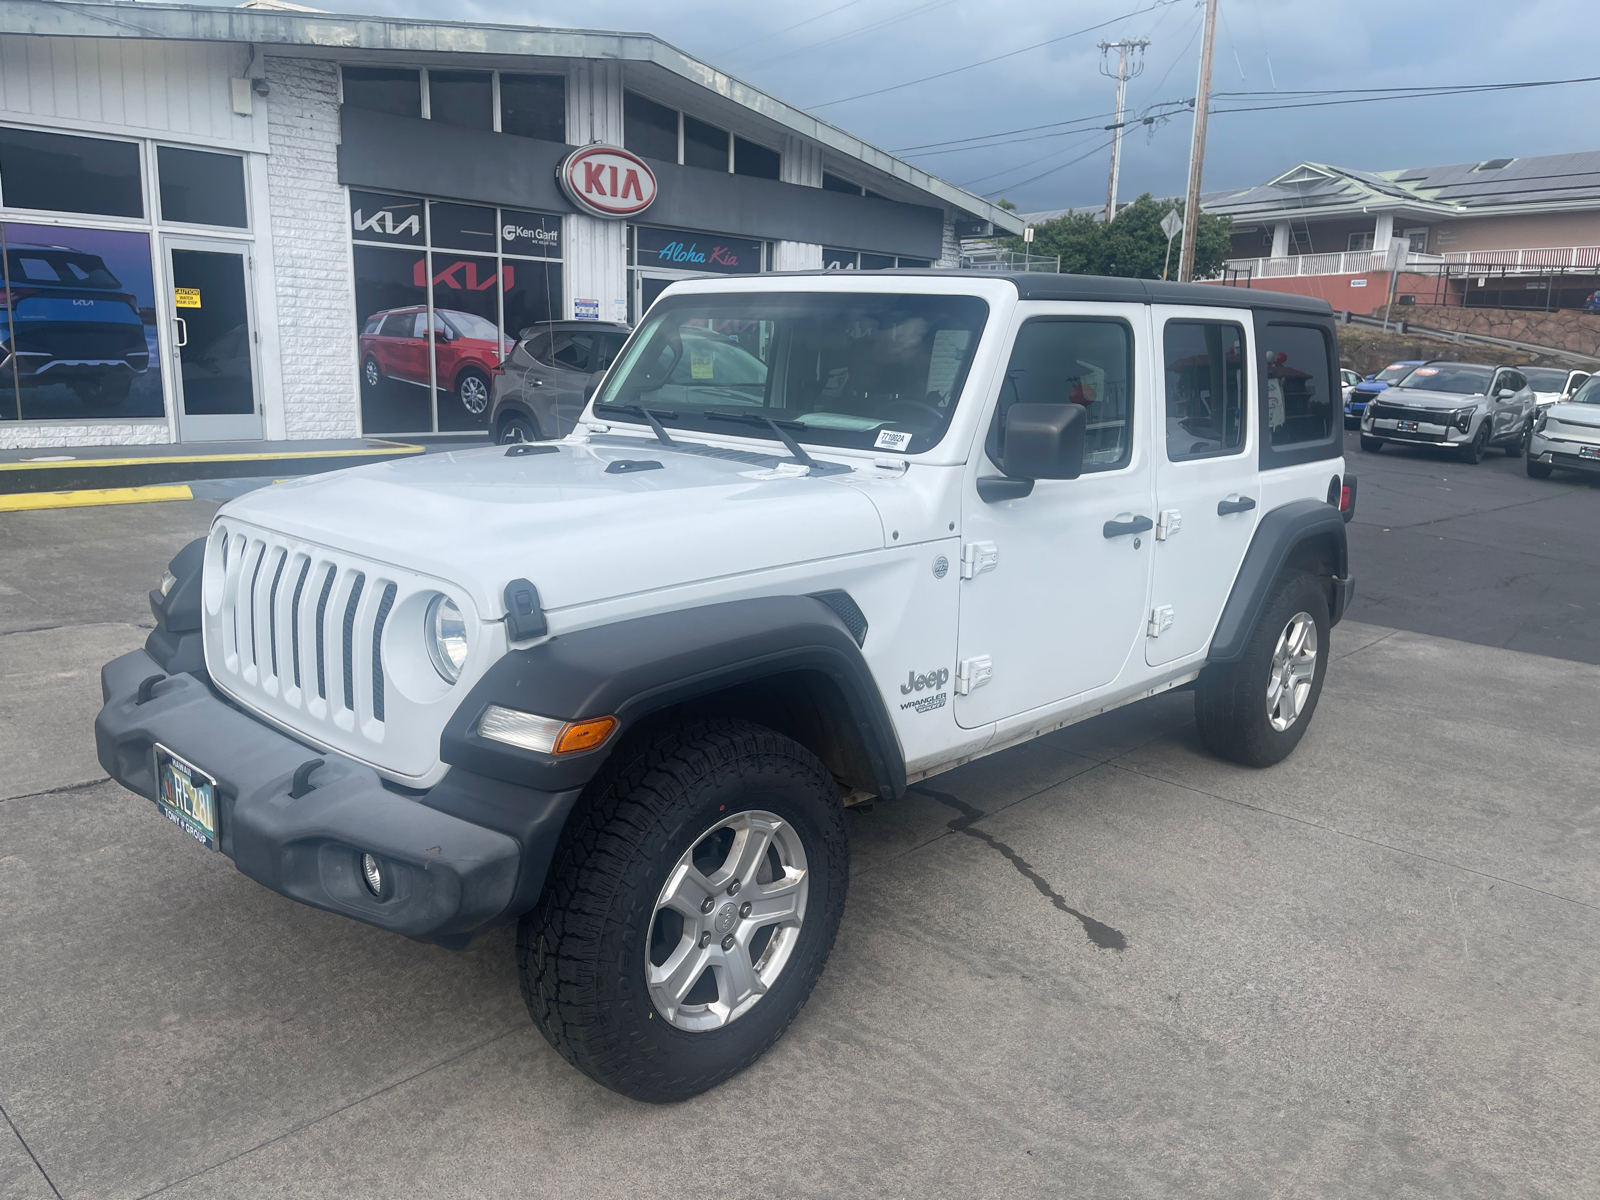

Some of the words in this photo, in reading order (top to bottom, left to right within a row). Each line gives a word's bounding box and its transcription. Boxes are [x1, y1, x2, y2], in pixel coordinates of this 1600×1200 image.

[583, 161, 643, 201] KIA
[354, 208, 419, 236] KIA
[516, 226, 535, 238] Ken
[535, 229, 558, 241] Garff
[658, 241, 706, 264] Aloha
[709, 246, 738, 266] Kia
[413, 258, 514, 292] KIA
[692, 357, 711, 366] SOLD
[900, 667, 949, 695] Jeep
[900, 692, 947, 710] WRANGLER
[164, 807, 180, 826] TONY
[185, 823, 207, 845] GROUP
